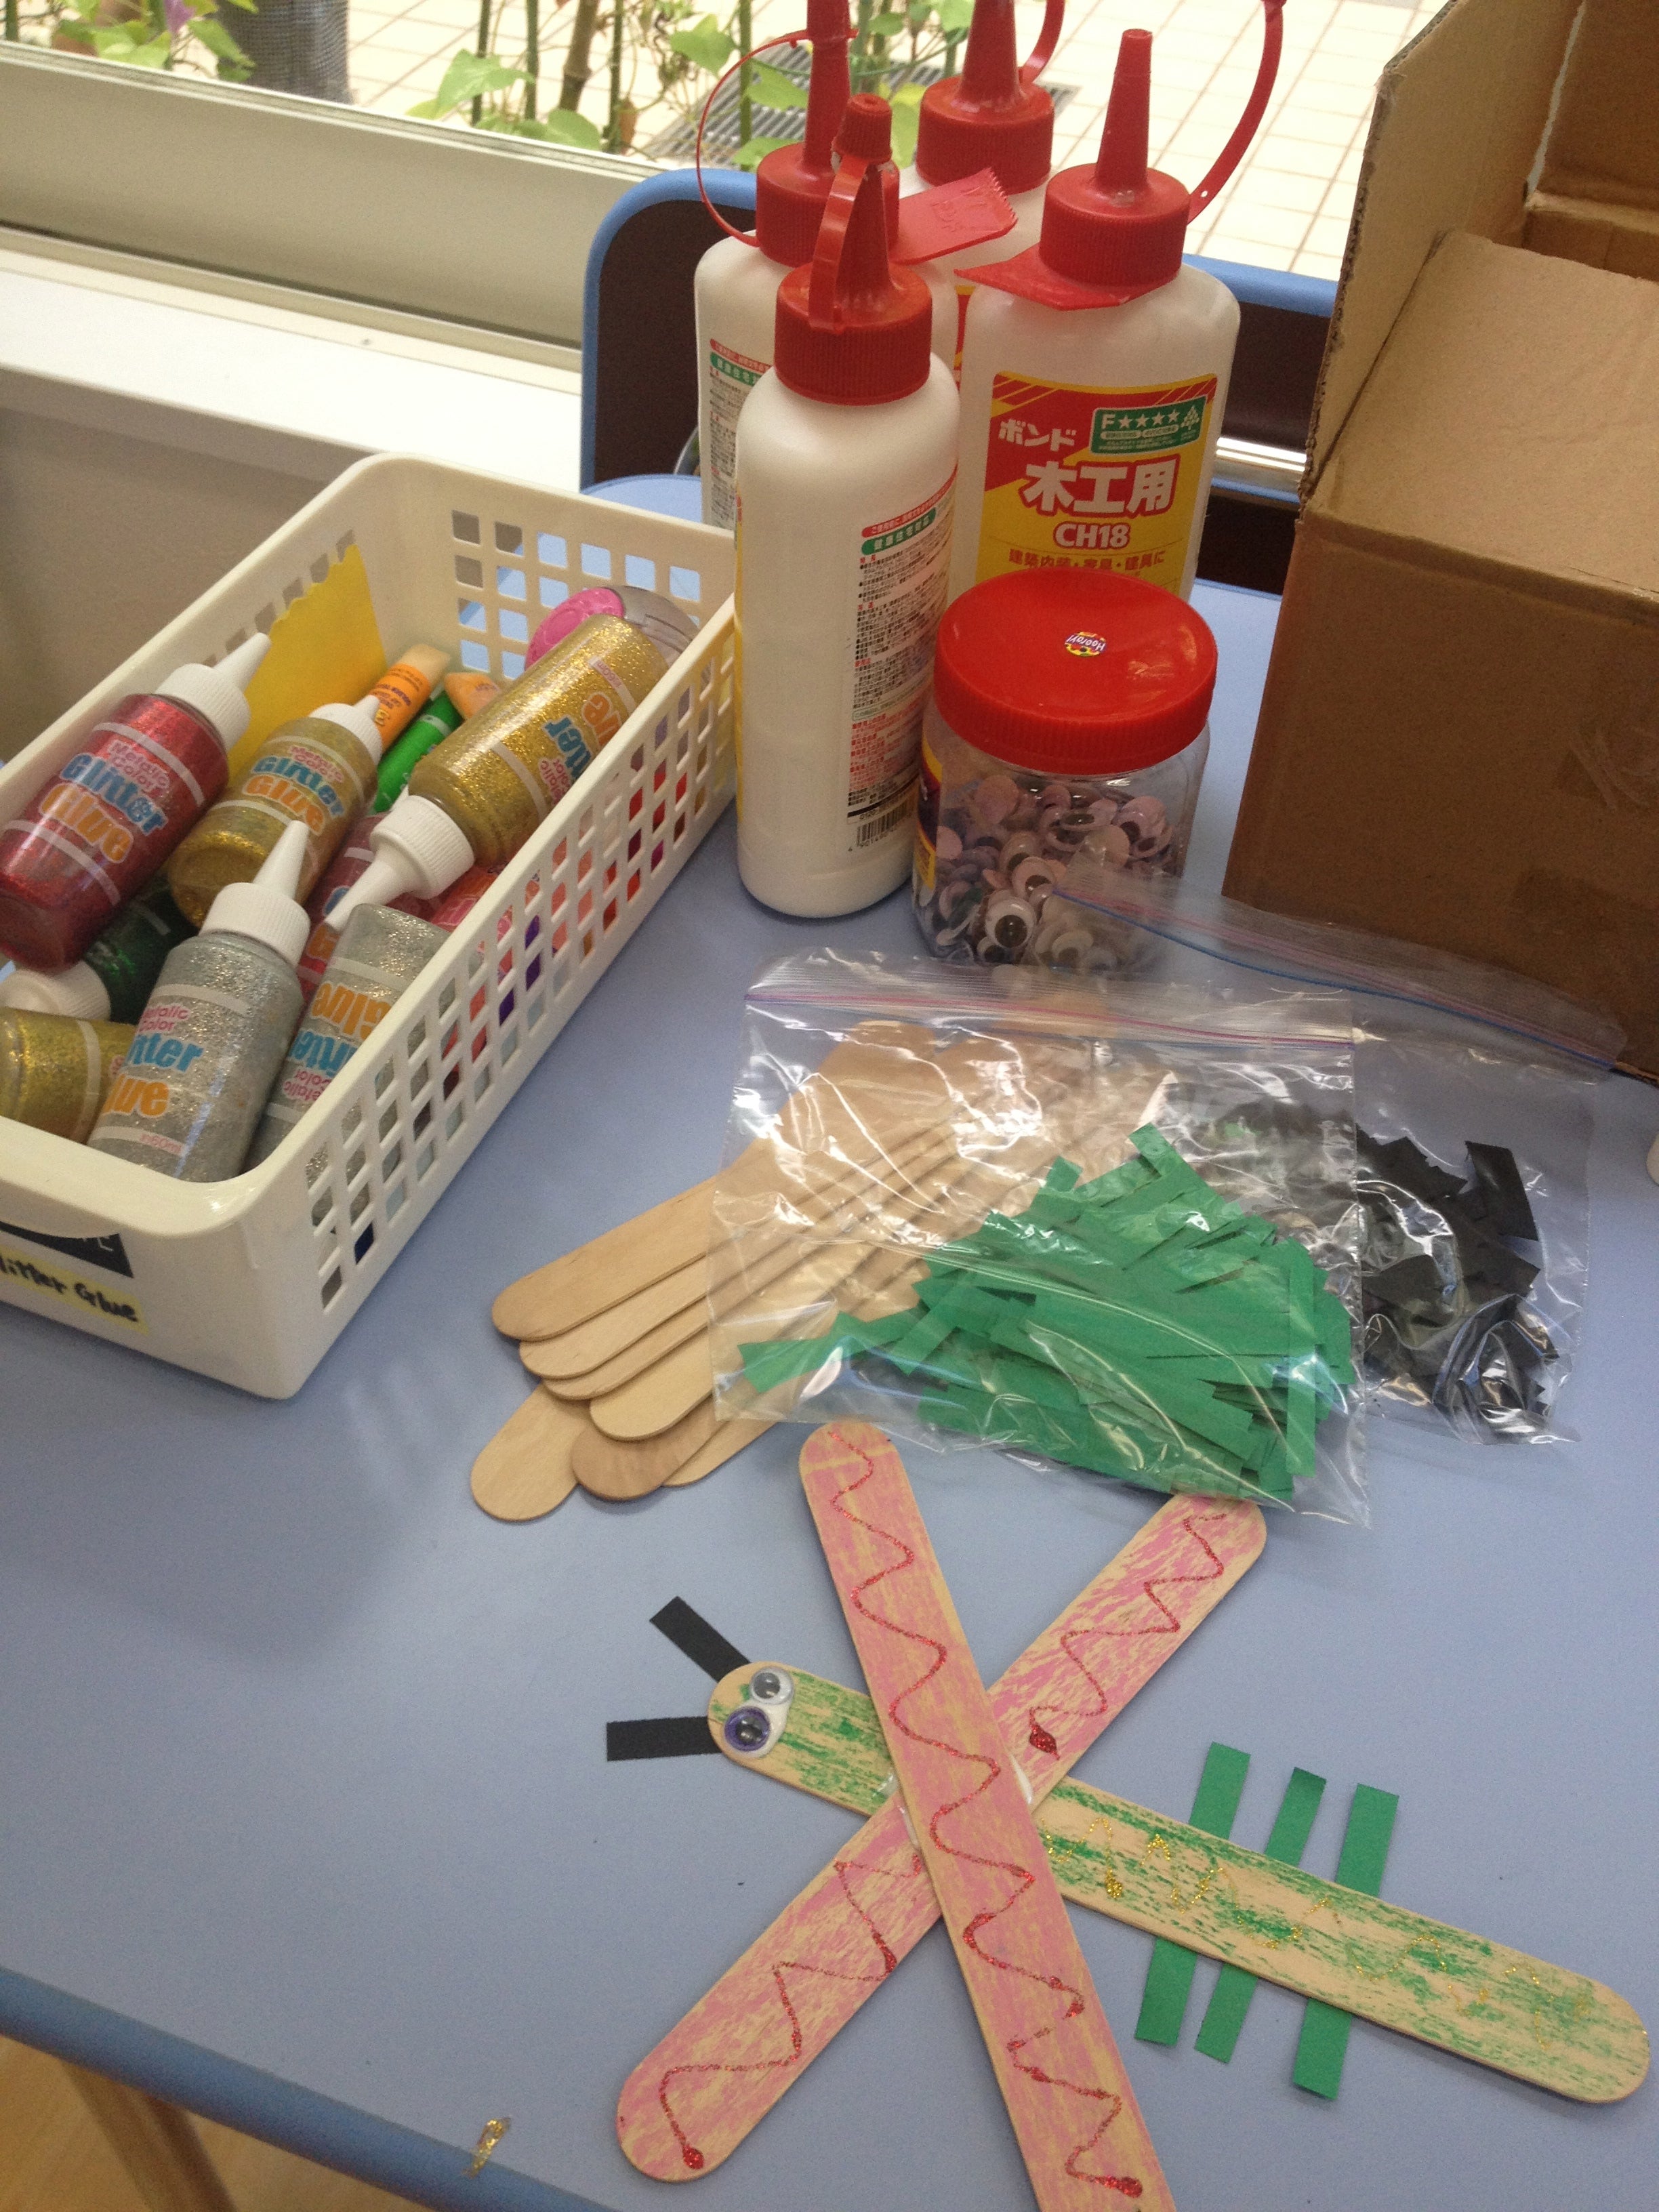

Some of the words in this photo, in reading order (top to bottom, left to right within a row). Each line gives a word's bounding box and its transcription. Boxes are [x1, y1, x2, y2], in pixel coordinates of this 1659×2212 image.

[998, 419, 1077, 451] ボンド
[1022, 457, 1178, 516] 木工用
[1054, 524, 1130, 548] CH18
[544, 716, 592, 779] tter
[583, 694, 622, 746] ue
[61, 754, 167, 836] Glitter
[244, 775, 325, 835] Glue
[252, 756, 345, 817] Glitter
[41, 784, 134, 863] Glue
[103, 1073, 169, 1117] lue
[74, 1282, 138, 1322] Glue
